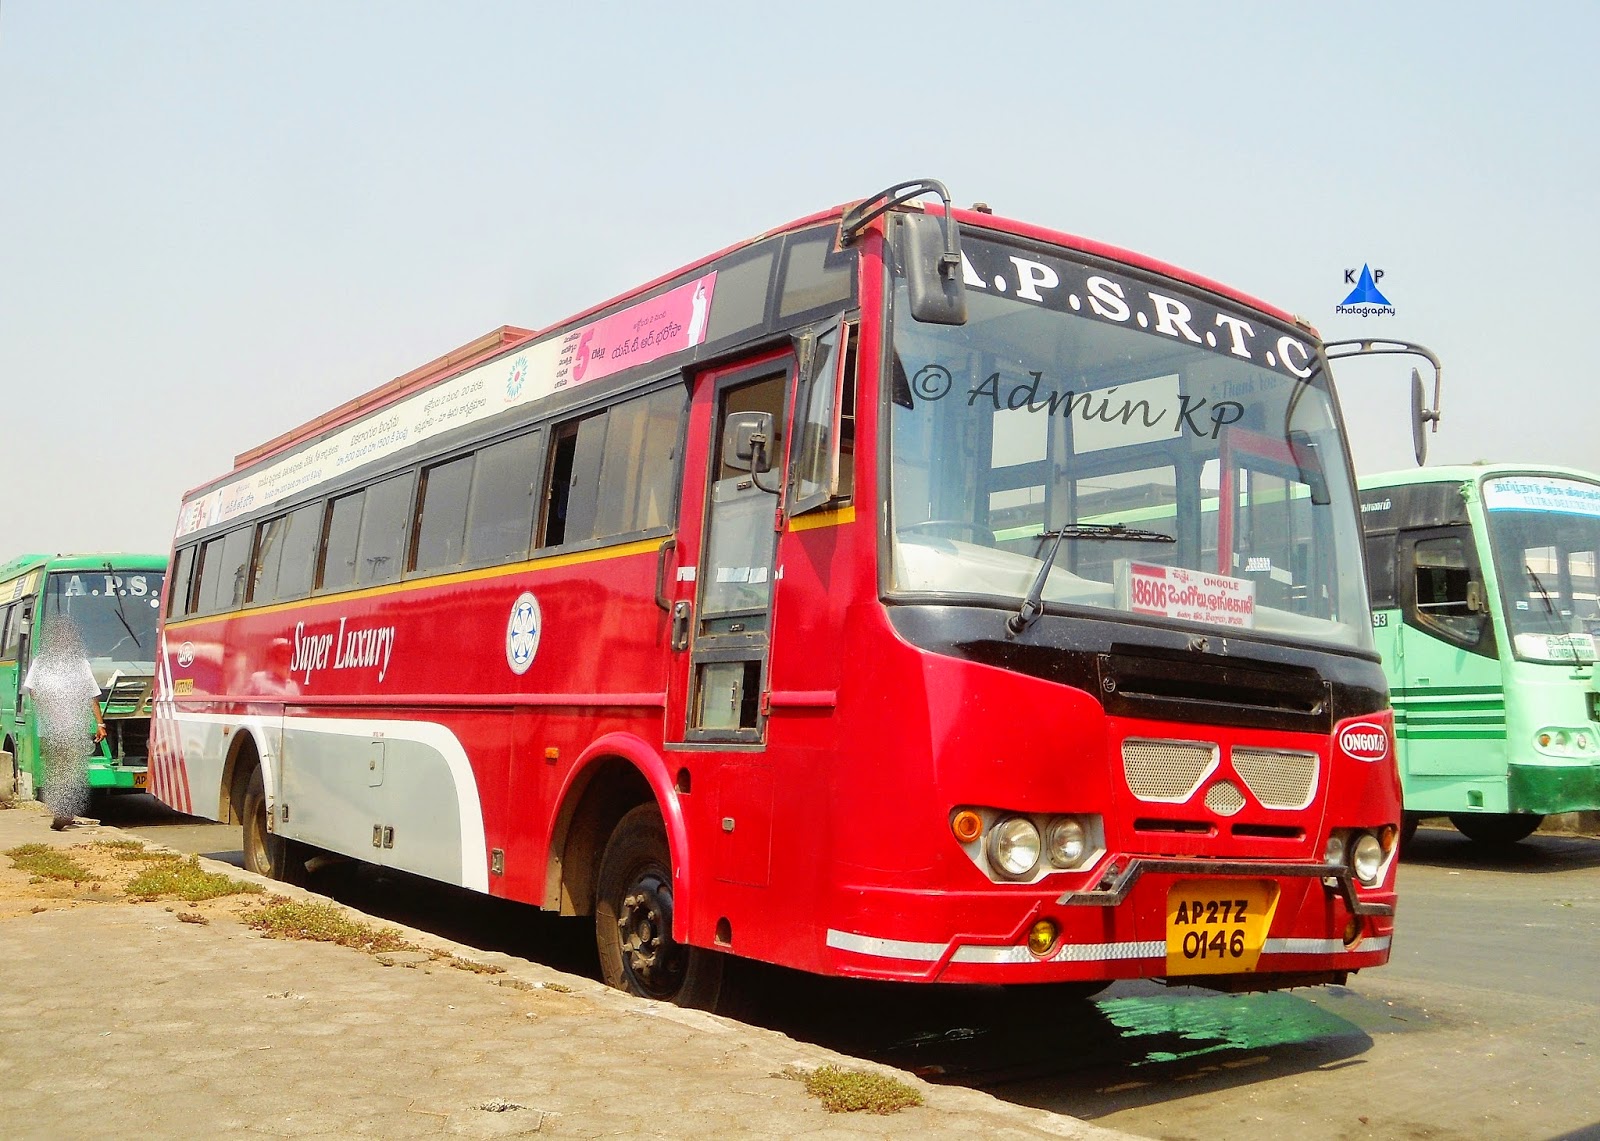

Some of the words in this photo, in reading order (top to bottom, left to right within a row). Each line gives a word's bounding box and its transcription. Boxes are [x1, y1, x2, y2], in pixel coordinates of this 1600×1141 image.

[573, 328, 595, 381] 5
[65, 575, 166, 597] A.P.S.
[1203, 577, 1240, 591] ONGOLE
[290, 620, 333, 685] Super
[333, 617, 395, 683] Luxury
[1343, 733, 1385, 752] ONGOLE
[1174, 899, 1248, 925] AP27Z
[1182, 929, 1245, 959] 0146
